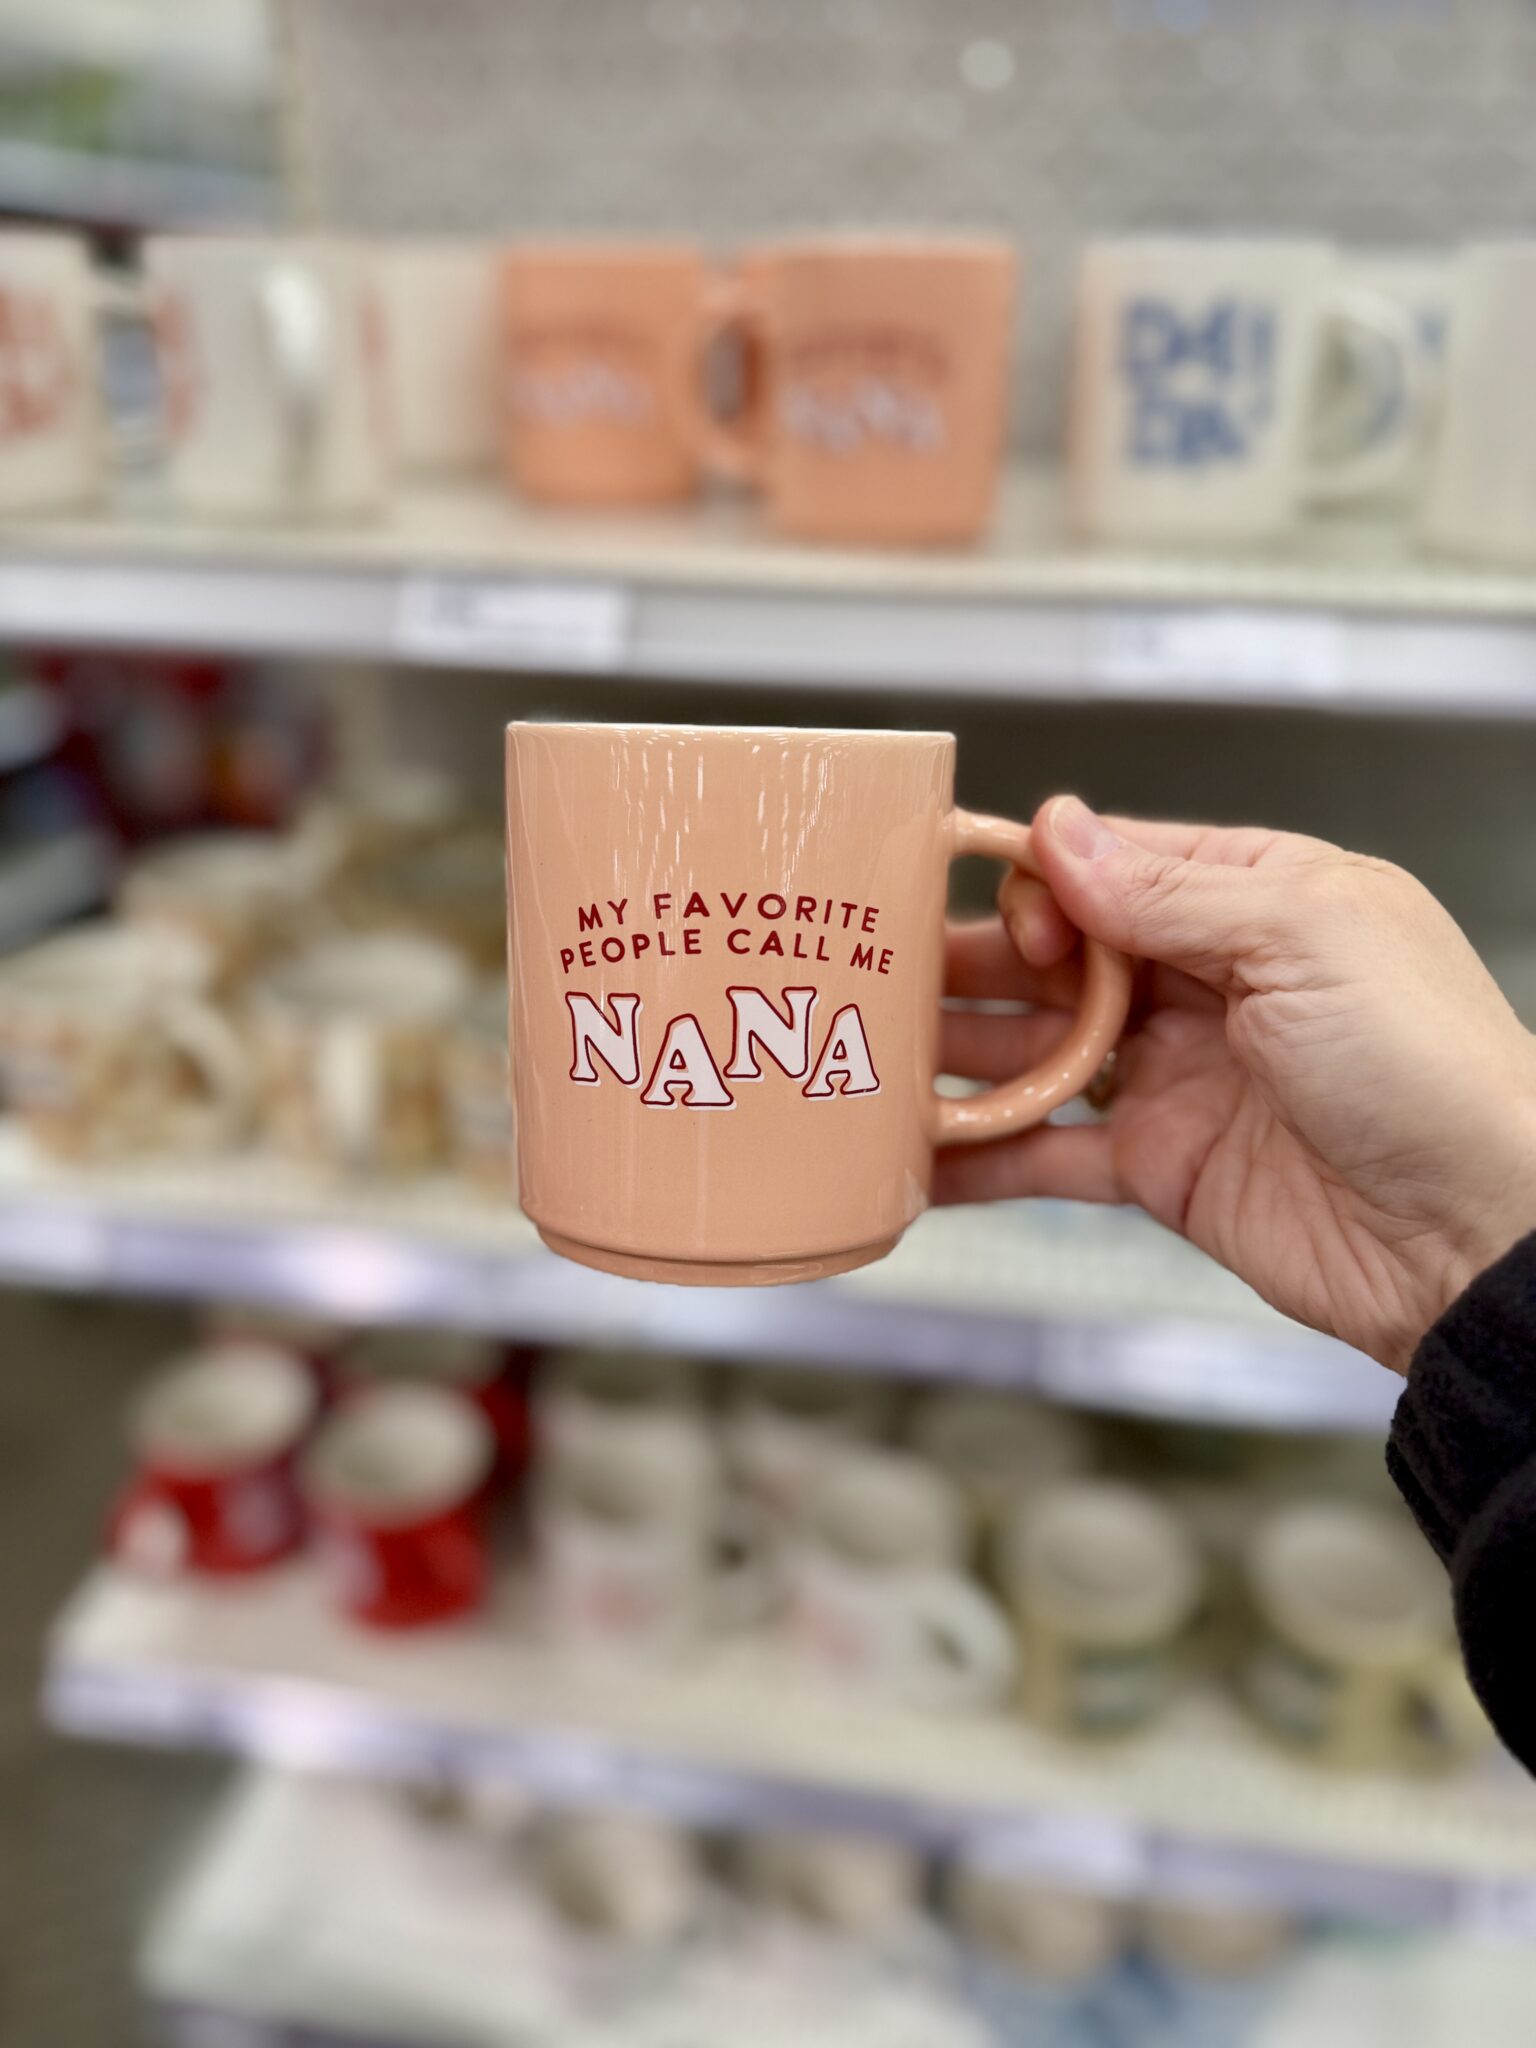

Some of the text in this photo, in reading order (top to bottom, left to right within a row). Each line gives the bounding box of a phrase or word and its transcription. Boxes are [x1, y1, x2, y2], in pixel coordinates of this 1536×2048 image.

[578, 891, 880, 933] MY FAVORITE
[560, 928, 894, 975] PEOPLE CALL ME
[564, 985, 882, 1110] NANA
